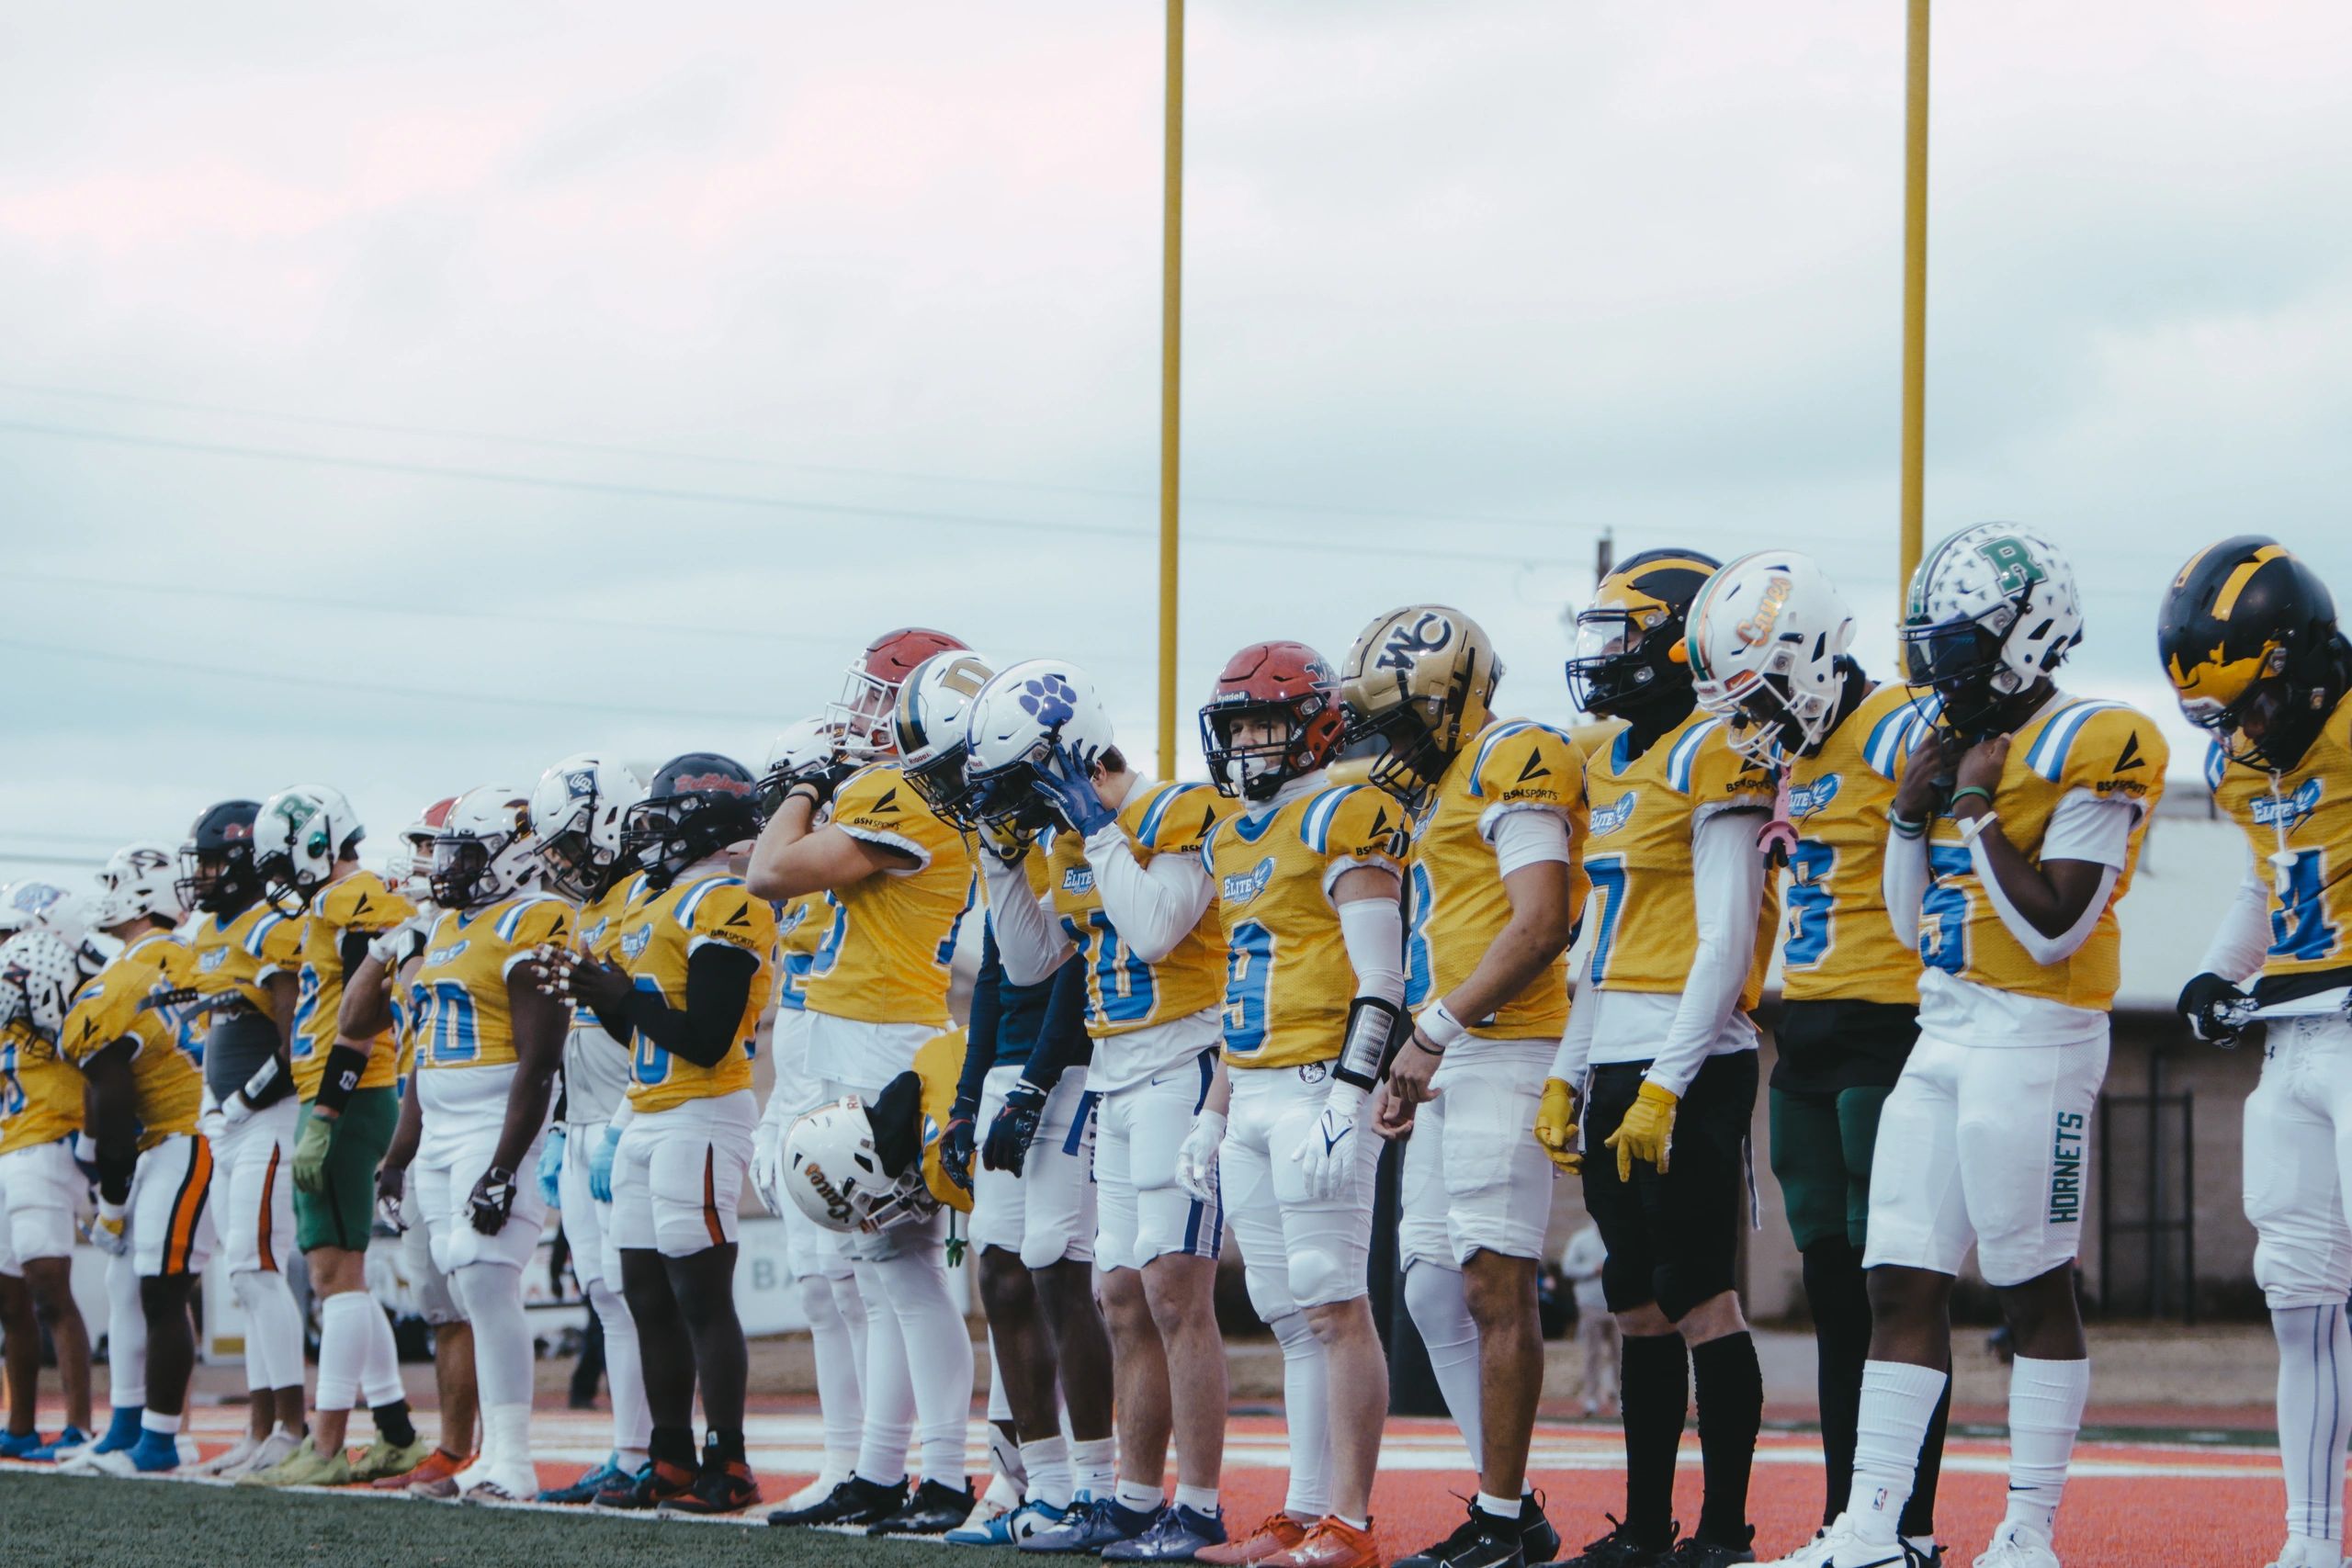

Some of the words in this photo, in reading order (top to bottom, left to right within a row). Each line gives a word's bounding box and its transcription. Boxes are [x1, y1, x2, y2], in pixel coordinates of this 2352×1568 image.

[1974, 536, 2048, 597] R
[1217, 691, 1246, 702] Riddell
[1223, 877, 1253, 898] ELITE
[1582, 852, 1629, 991] 7
[2049, 1111, 2083, 1224] HORNETS
